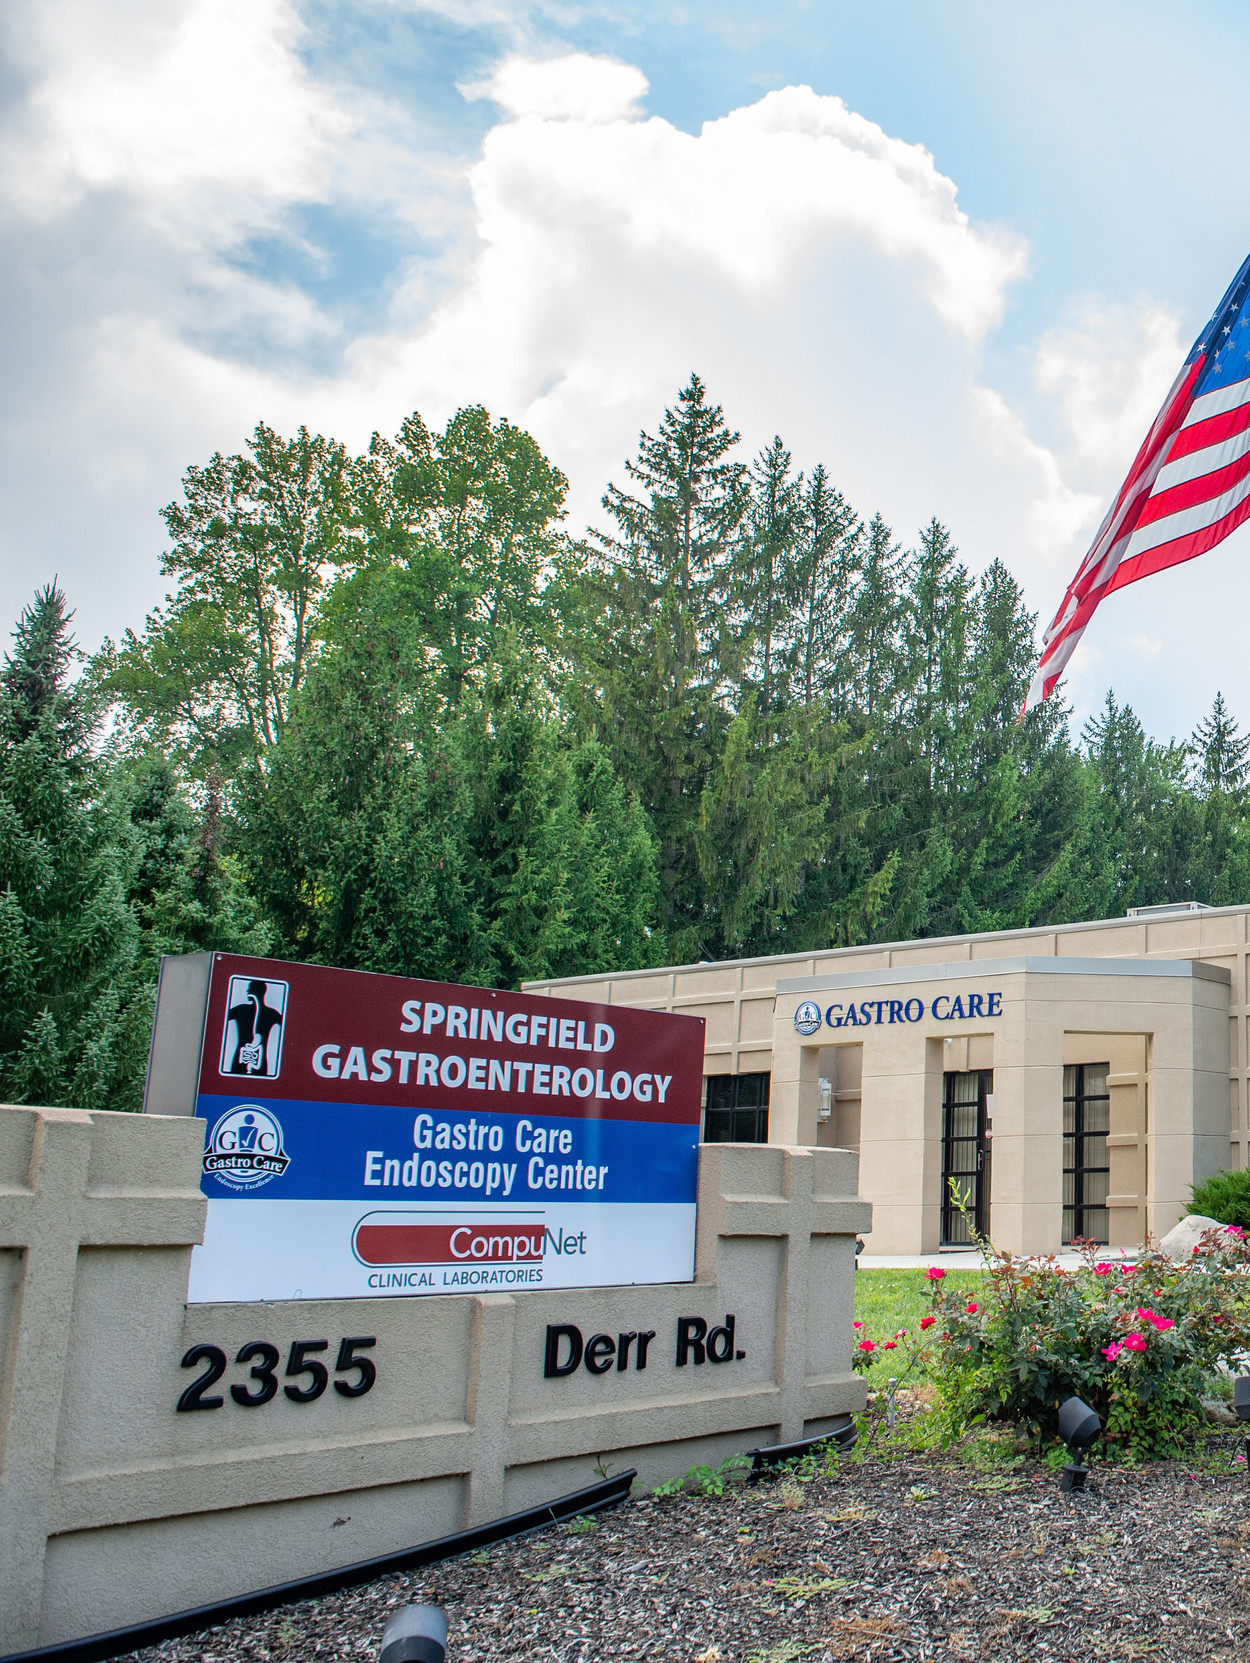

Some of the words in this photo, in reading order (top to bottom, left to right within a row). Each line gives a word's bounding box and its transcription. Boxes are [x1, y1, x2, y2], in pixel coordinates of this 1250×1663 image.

[400, 1000, 616, 1053] SPRINGFIELD
[825, 998, 925, 1028] GASTRO
[931, 992, 1003, 1020] CARE
[311, 1043, 673, 1103] GASTROENTEROLOGY
[413, 1113, 504, 1152] Gastro
[515, 1120, 573, 1154] Care
[205, 1156, 251, 1169] Gastro
[252, 1156, 283, 1172] Care
[214, 1173, 244, 1191] Endoscopy
[245, 1174, 275, 1190] Excellence
[363, 1151, 517, 1196] Endoscopy
[527, 1156, 609, 1190] Center
[450, 1227, 587, 1261] CompuNet
[368, 1272, 436, 1288] CLINICAL
[443, 1269, 543, 1286] LABORATORIES
[544, 1323, 656, 1379] Derr
[675, 1314, 746, 1367] Rd.
[176, 1336, 377, 1412] 2355
